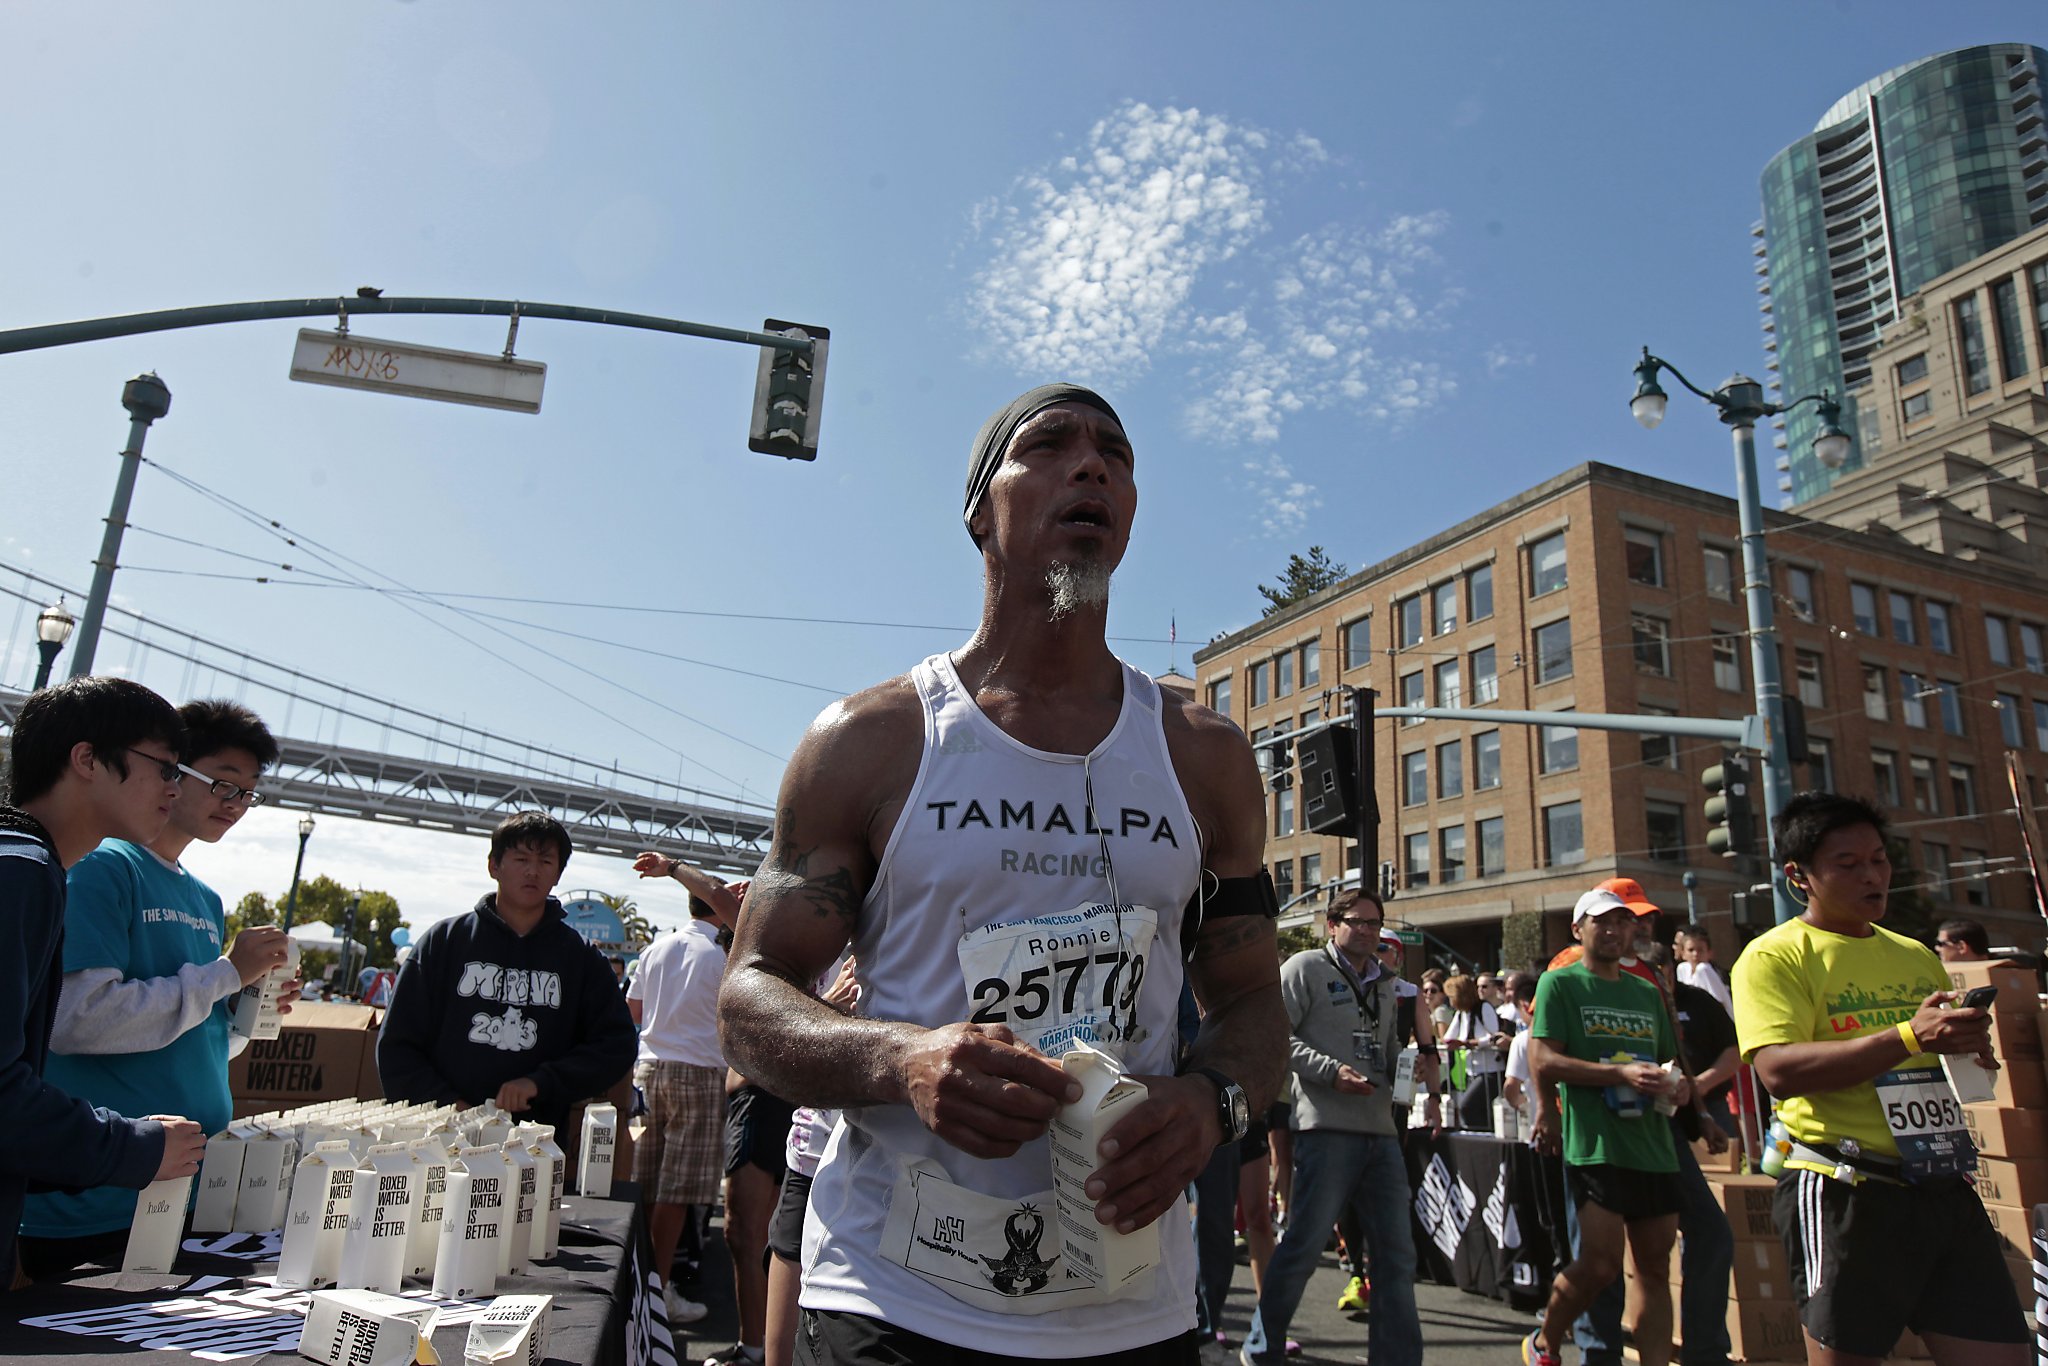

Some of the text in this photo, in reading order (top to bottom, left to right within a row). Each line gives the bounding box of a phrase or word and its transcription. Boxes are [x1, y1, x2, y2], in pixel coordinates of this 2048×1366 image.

[926, 799, 1179, 850] TAMALPA
[1001, 849, 1110, 878] RACING
[142, 907, 162, 923] THE
[1082, 903, 1135, 920] MARATHON
[1028, 928, 1111, 956] Ronnie
[246, 1063, 310, 1091] WATER
[331, 1170, 355, 1185] BOXED
[427, 1166, 446, 1180] BOXED
[207, 1176, 228, 1190] hello
[248, 1176, 268, 1190] hello
[379, 1175, 407, 1191] BOXED
[426, 1180, 445, 1194] WATER
[471, 1178, 498, 1193] BOXED
[329, 1184, 352, 1199] WATER
[377, 1190, 405, 1206] WATER
[146, 1199, 171, 1215] hello
[326, 1201, 335, 1215] IS
[423, 1195, 431, 1209] IS
[470, 1193, 498, 1209] WATER
[518, 1196, 524, 1209] IS
[293, 1210, 311, 1226] hello
[323, 1214, 348, 1230] BETTE
[374, 1207, 384, 1222] IS
[467, 1209, 477, 1224] IS
[371, 1221, 406, 1238] BETTER.
[465, 1223, 499, 1240] BETTER.
[916, 1234, 979, 1265] Hospitality House
[348, 1313, 361, 1328] IS
[329, 1310, 352, 1362] BETTER.
[349, 1318, 371, 1363] WATER
[359, 1320, 381, 1365] BOXED
